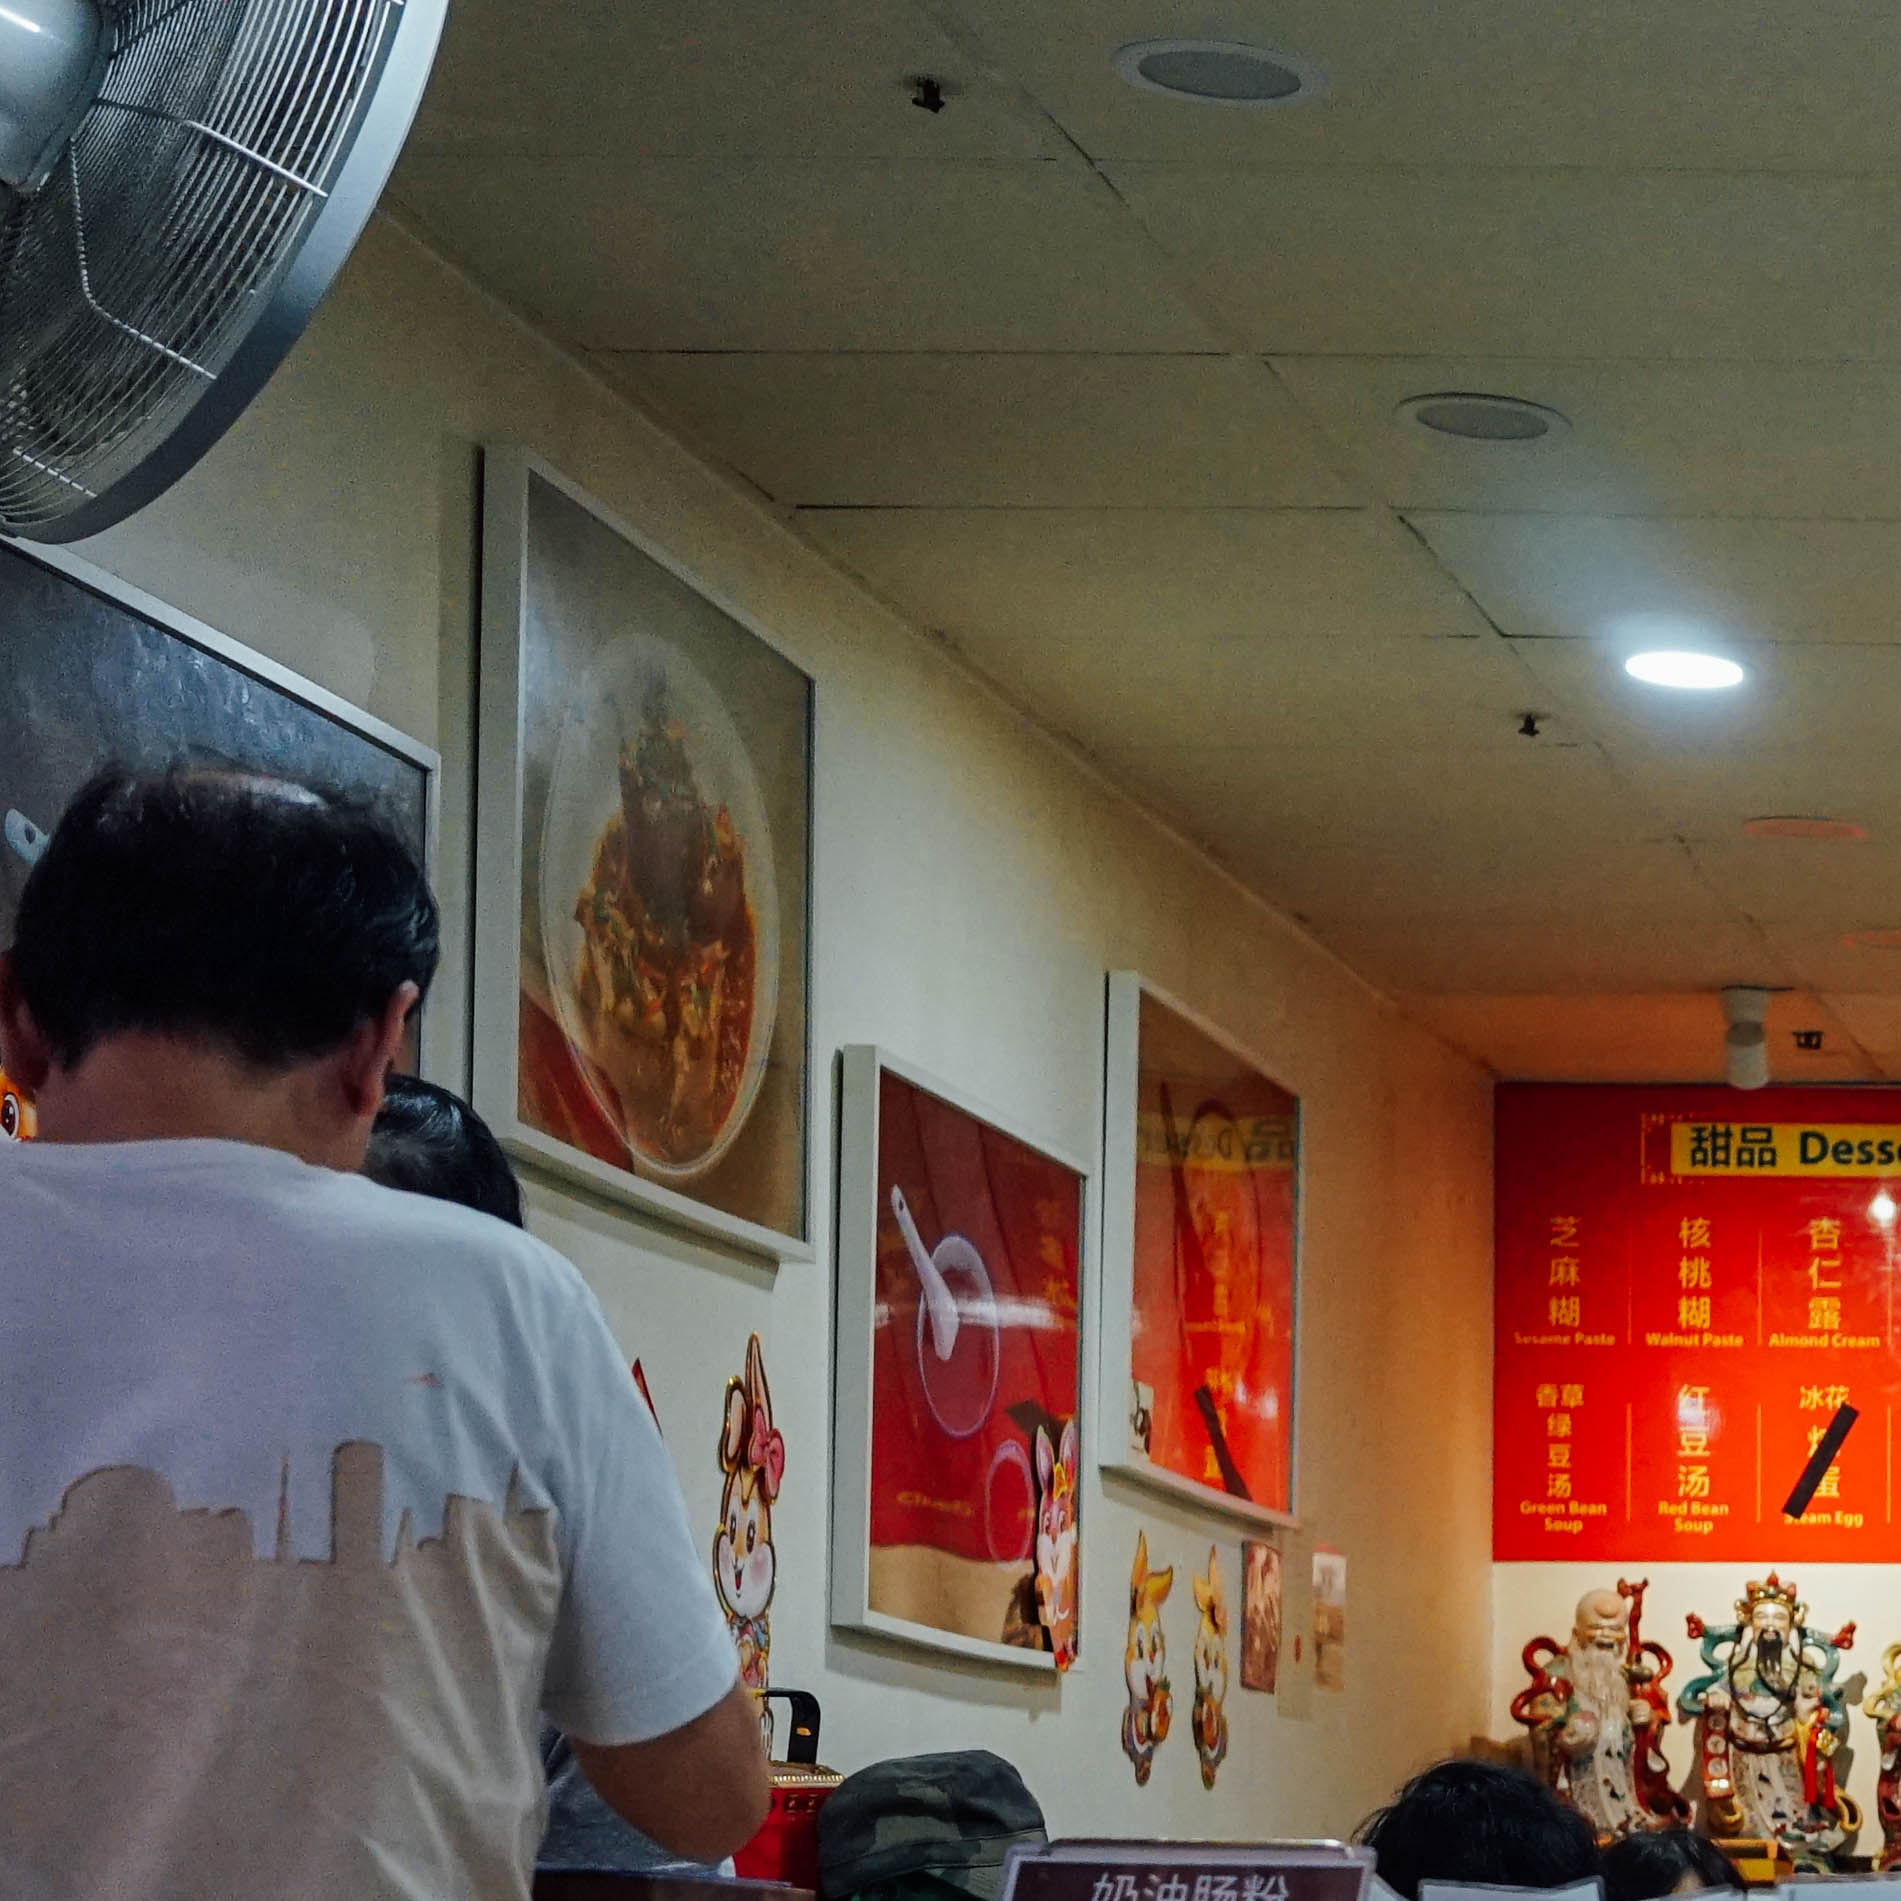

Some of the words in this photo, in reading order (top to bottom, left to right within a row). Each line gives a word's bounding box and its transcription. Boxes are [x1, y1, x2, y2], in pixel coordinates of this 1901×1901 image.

[1690, 1126, 1777, 1168] 甜品
[1549, 1216, 1581, 1328] 芝麻糊
[1678, 1216, 1712, 1329] 核桃糊
[1808, 1216, 1841, 1330] 杏仁露
[1575, 1332, 1616, 1346] Paste
[1645, 1332, 1699, 1347] Walnut
[1703, 1332, 1744, 1347] Paste
[1769, 1333, 1828, 1348] Almond
[1832, 1333, 1881, 1348] Cream
[1677, 1384, 1712, 1498] 红豆汤
[1520, 1501, 1565, 1515] Green
[1569, 1501, 1608, 1515] Bean
[1658, 1501, 1686, 1515] Red
[1691, 1501, 1729, 1515] Bean
[1545, 1517, 1583, 1534] Soup
[1674, 1517, 1713, 1534] Soup
[1784, 1510, 1831, 1526] Seam
[1835, 1511, 1864, 1529] Egg
